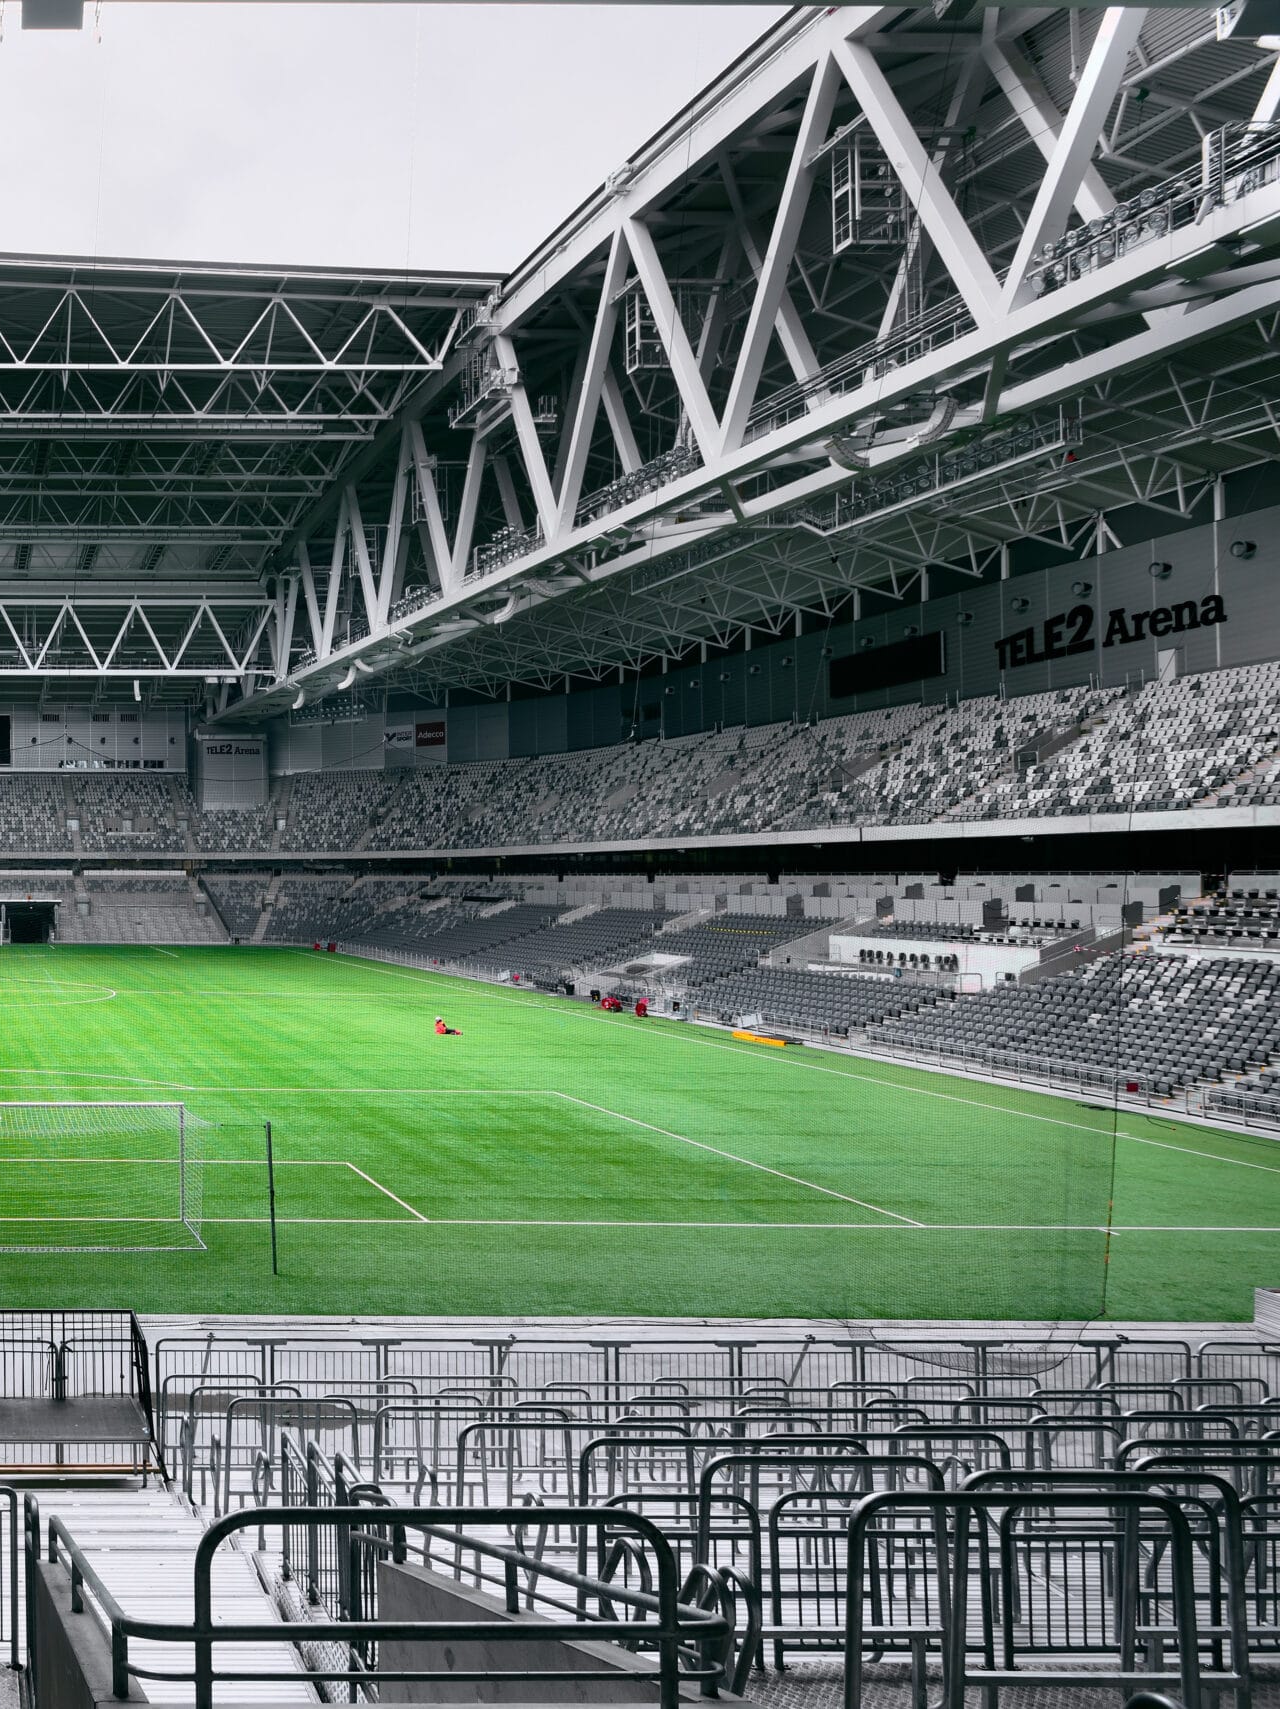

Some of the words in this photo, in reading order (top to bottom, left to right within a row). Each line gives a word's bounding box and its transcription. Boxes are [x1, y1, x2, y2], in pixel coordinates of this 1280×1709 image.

[994, 604, 1095, 670] TELE2
[1102, 594, 1228, 648] Arena
[417, 730, 444, 739] Adecco
[206, 743, 233, 755] TELE2
[234, 746, 261, 755] Arena
